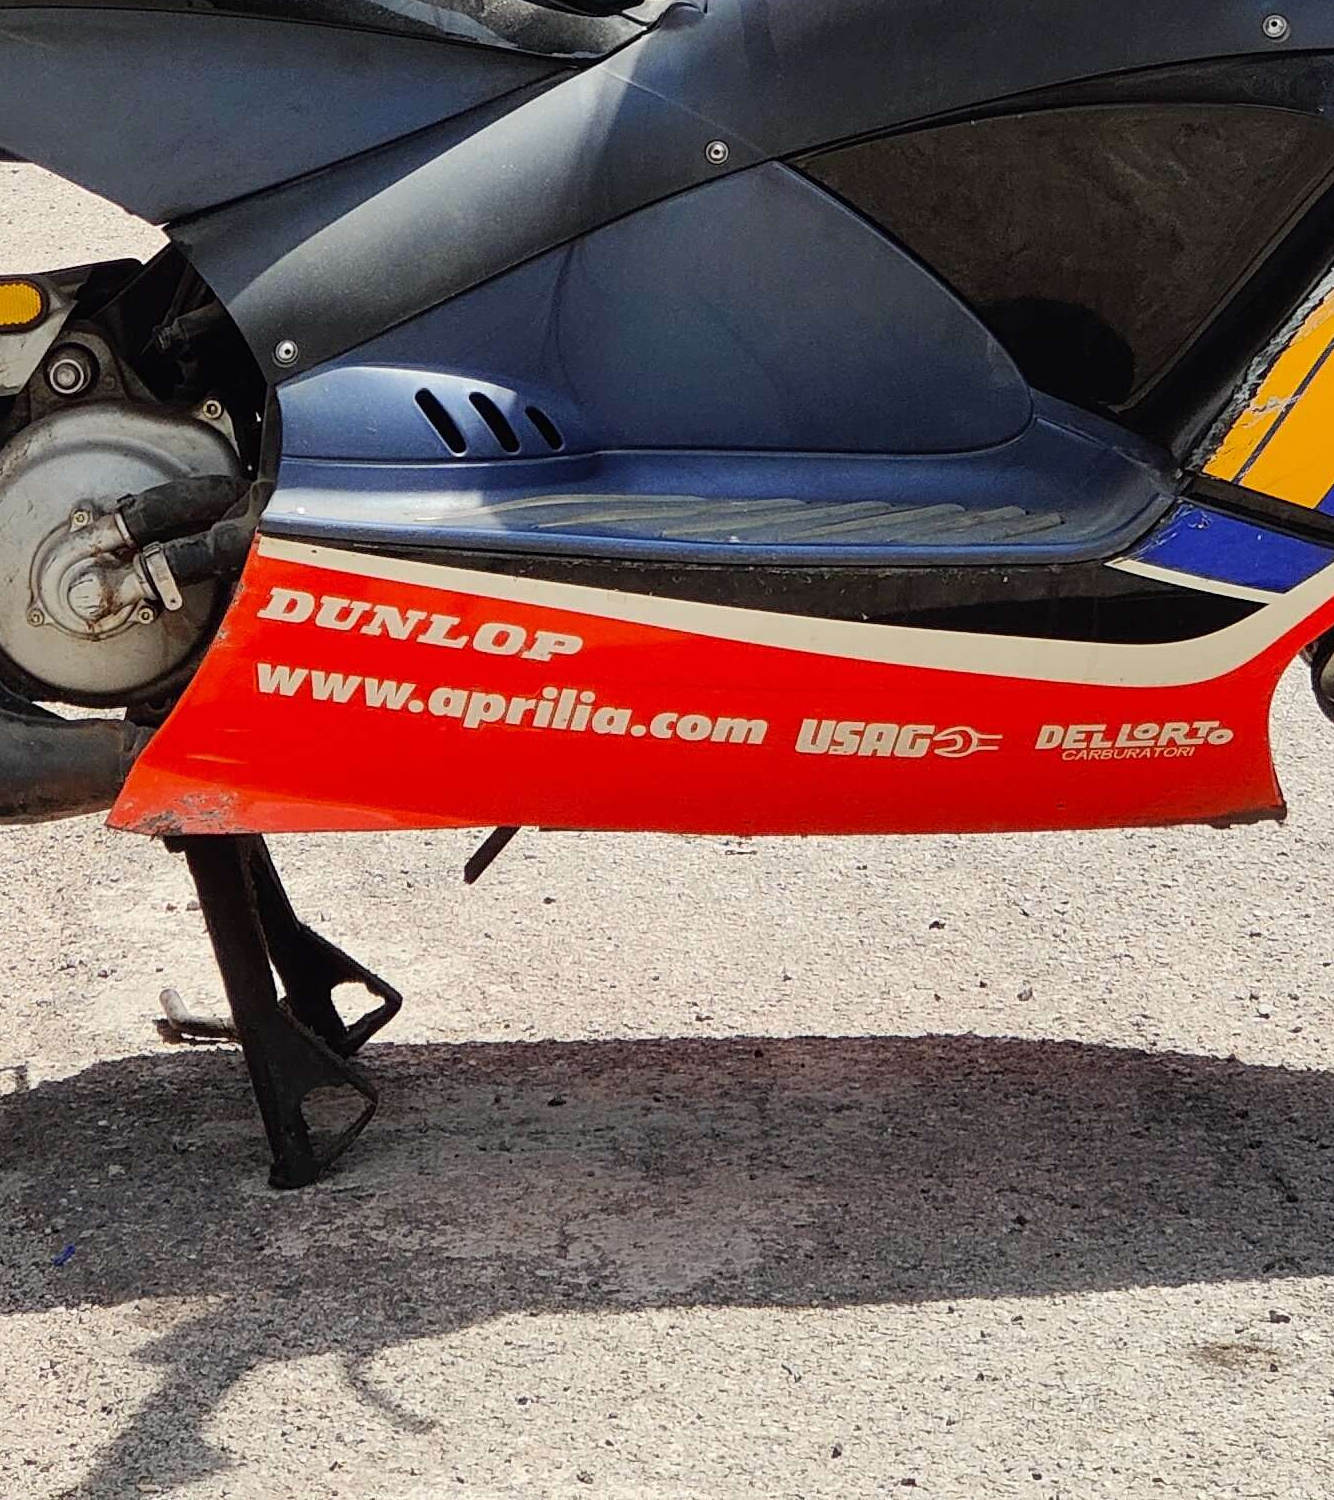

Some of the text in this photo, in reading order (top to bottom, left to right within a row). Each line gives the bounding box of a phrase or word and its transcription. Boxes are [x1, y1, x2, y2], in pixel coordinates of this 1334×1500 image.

[256, 586, 584, 663] DUNLOP
[257, 662, 769, 746] www.aprilia.com
[795, 717, 936, 759] USAG
[1061, 746, 1196, 762] CARBURATORI
